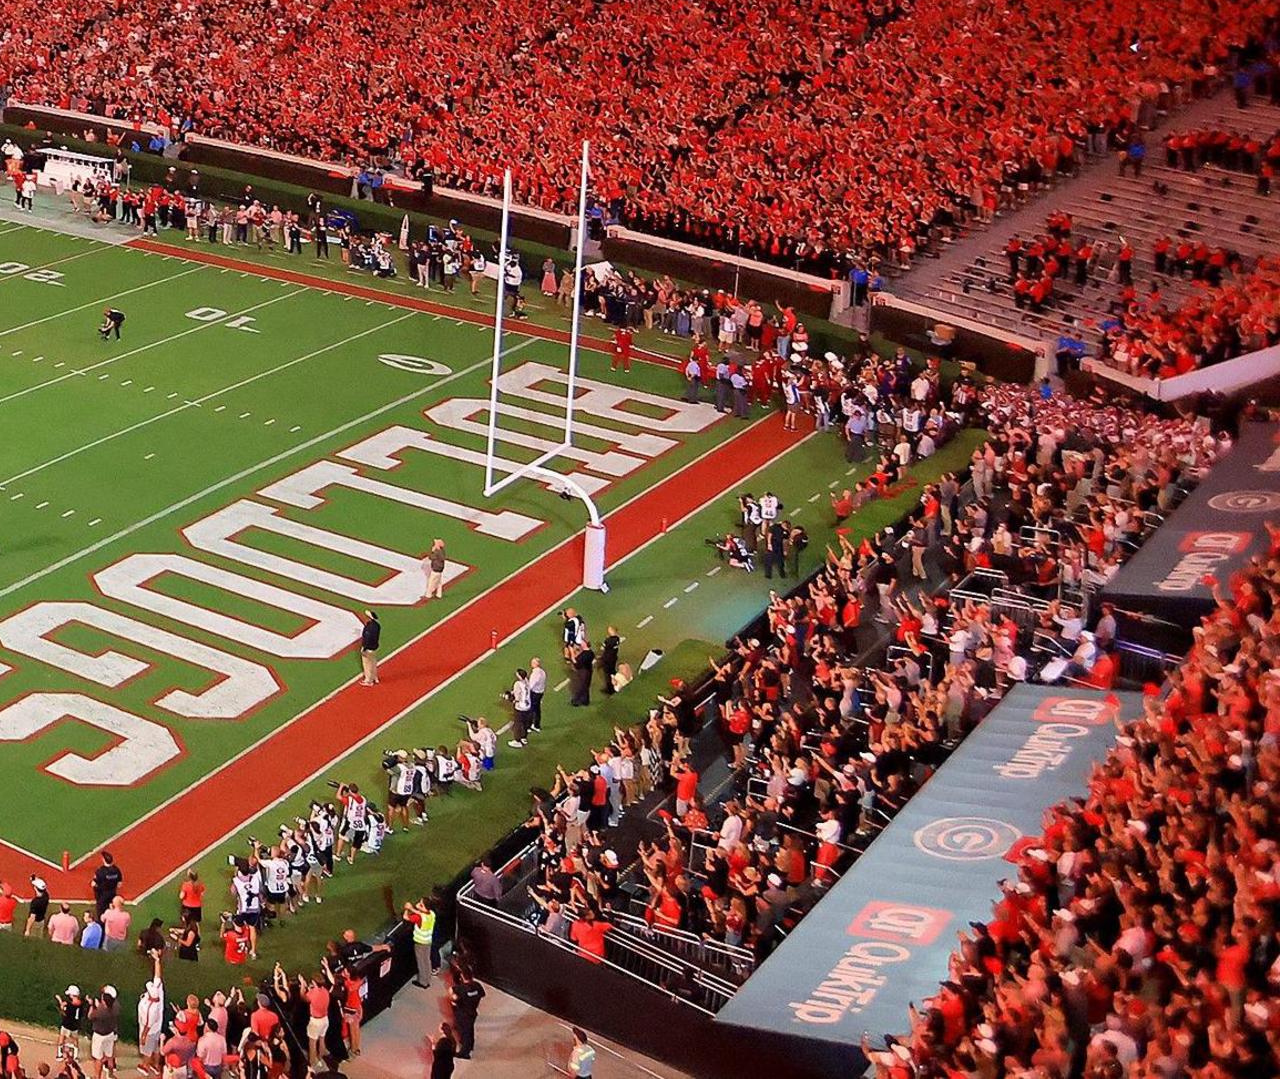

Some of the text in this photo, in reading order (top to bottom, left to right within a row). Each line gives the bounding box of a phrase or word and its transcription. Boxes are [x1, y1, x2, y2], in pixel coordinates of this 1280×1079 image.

[184, 306, 256, 329] 10
[993, 722, 1089, 780] QuikTrip
[869, 907, 934, 939] QT
[788, 941, 911, 1024] QuikTrip
